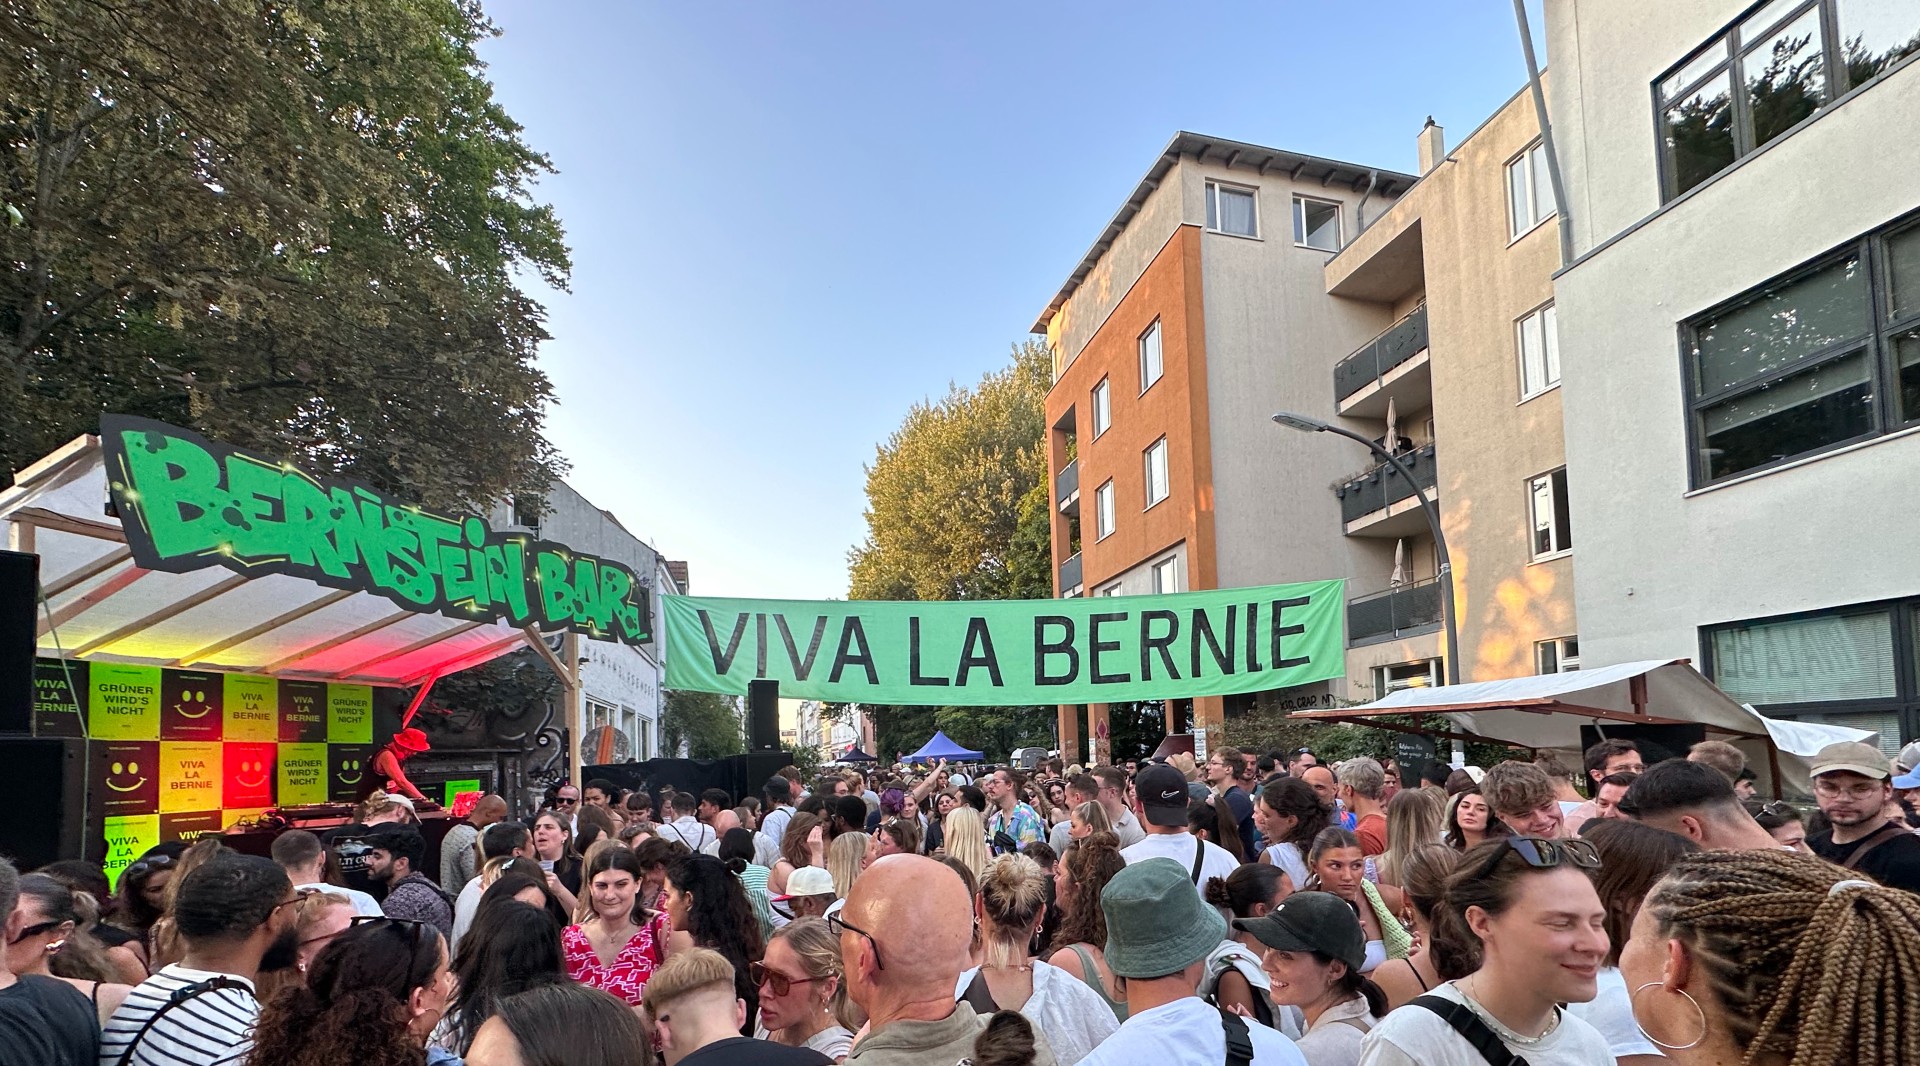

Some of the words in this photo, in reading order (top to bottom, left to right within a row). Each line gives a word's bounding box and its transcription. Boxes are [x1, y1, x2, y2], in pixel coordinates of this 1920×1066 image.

[696, 608, 879, 685] VIVA
[908, 616, 1004, 687] LA
[1034, 595, 1312, 687] BERNIE
[34, 679, 69, 690] VIVA
[98, 683, 154, 695] GRÜNER
[41, 691, 60, 701] LA
[103, 695, 150, 705] WIRD'S
[241, 693, 264, 702] VIVA
[293, 696, 314, 704] VIVA
[245, 702, 259, 711] LA
[332, 698, 369, 707] GRÜNER
[34, 702, 78, 713] ERNIE
[107, 706, 146, 716] NICHT
[297, 705, 310, 713] LA
[336, 707, 366, 716] WIRD'S
[233, 712, 272, 721] BERNIE
[286, 713, 321, 723] BERNIE
[338, 716, 363, 724] NICHT
[180, 760, 206, 769] VIVA
[284, 759, 323, 768] GRÜNER
[185, 770, 200, 779] LA
[287, 768, 320, 777] WIRD'S
[171, 780, 213, 790] BERNIE
[290, 777, 318, 787] NICHT
[111, 836, 140, 847] VIVA
[117, 847, 134, 857] LA
